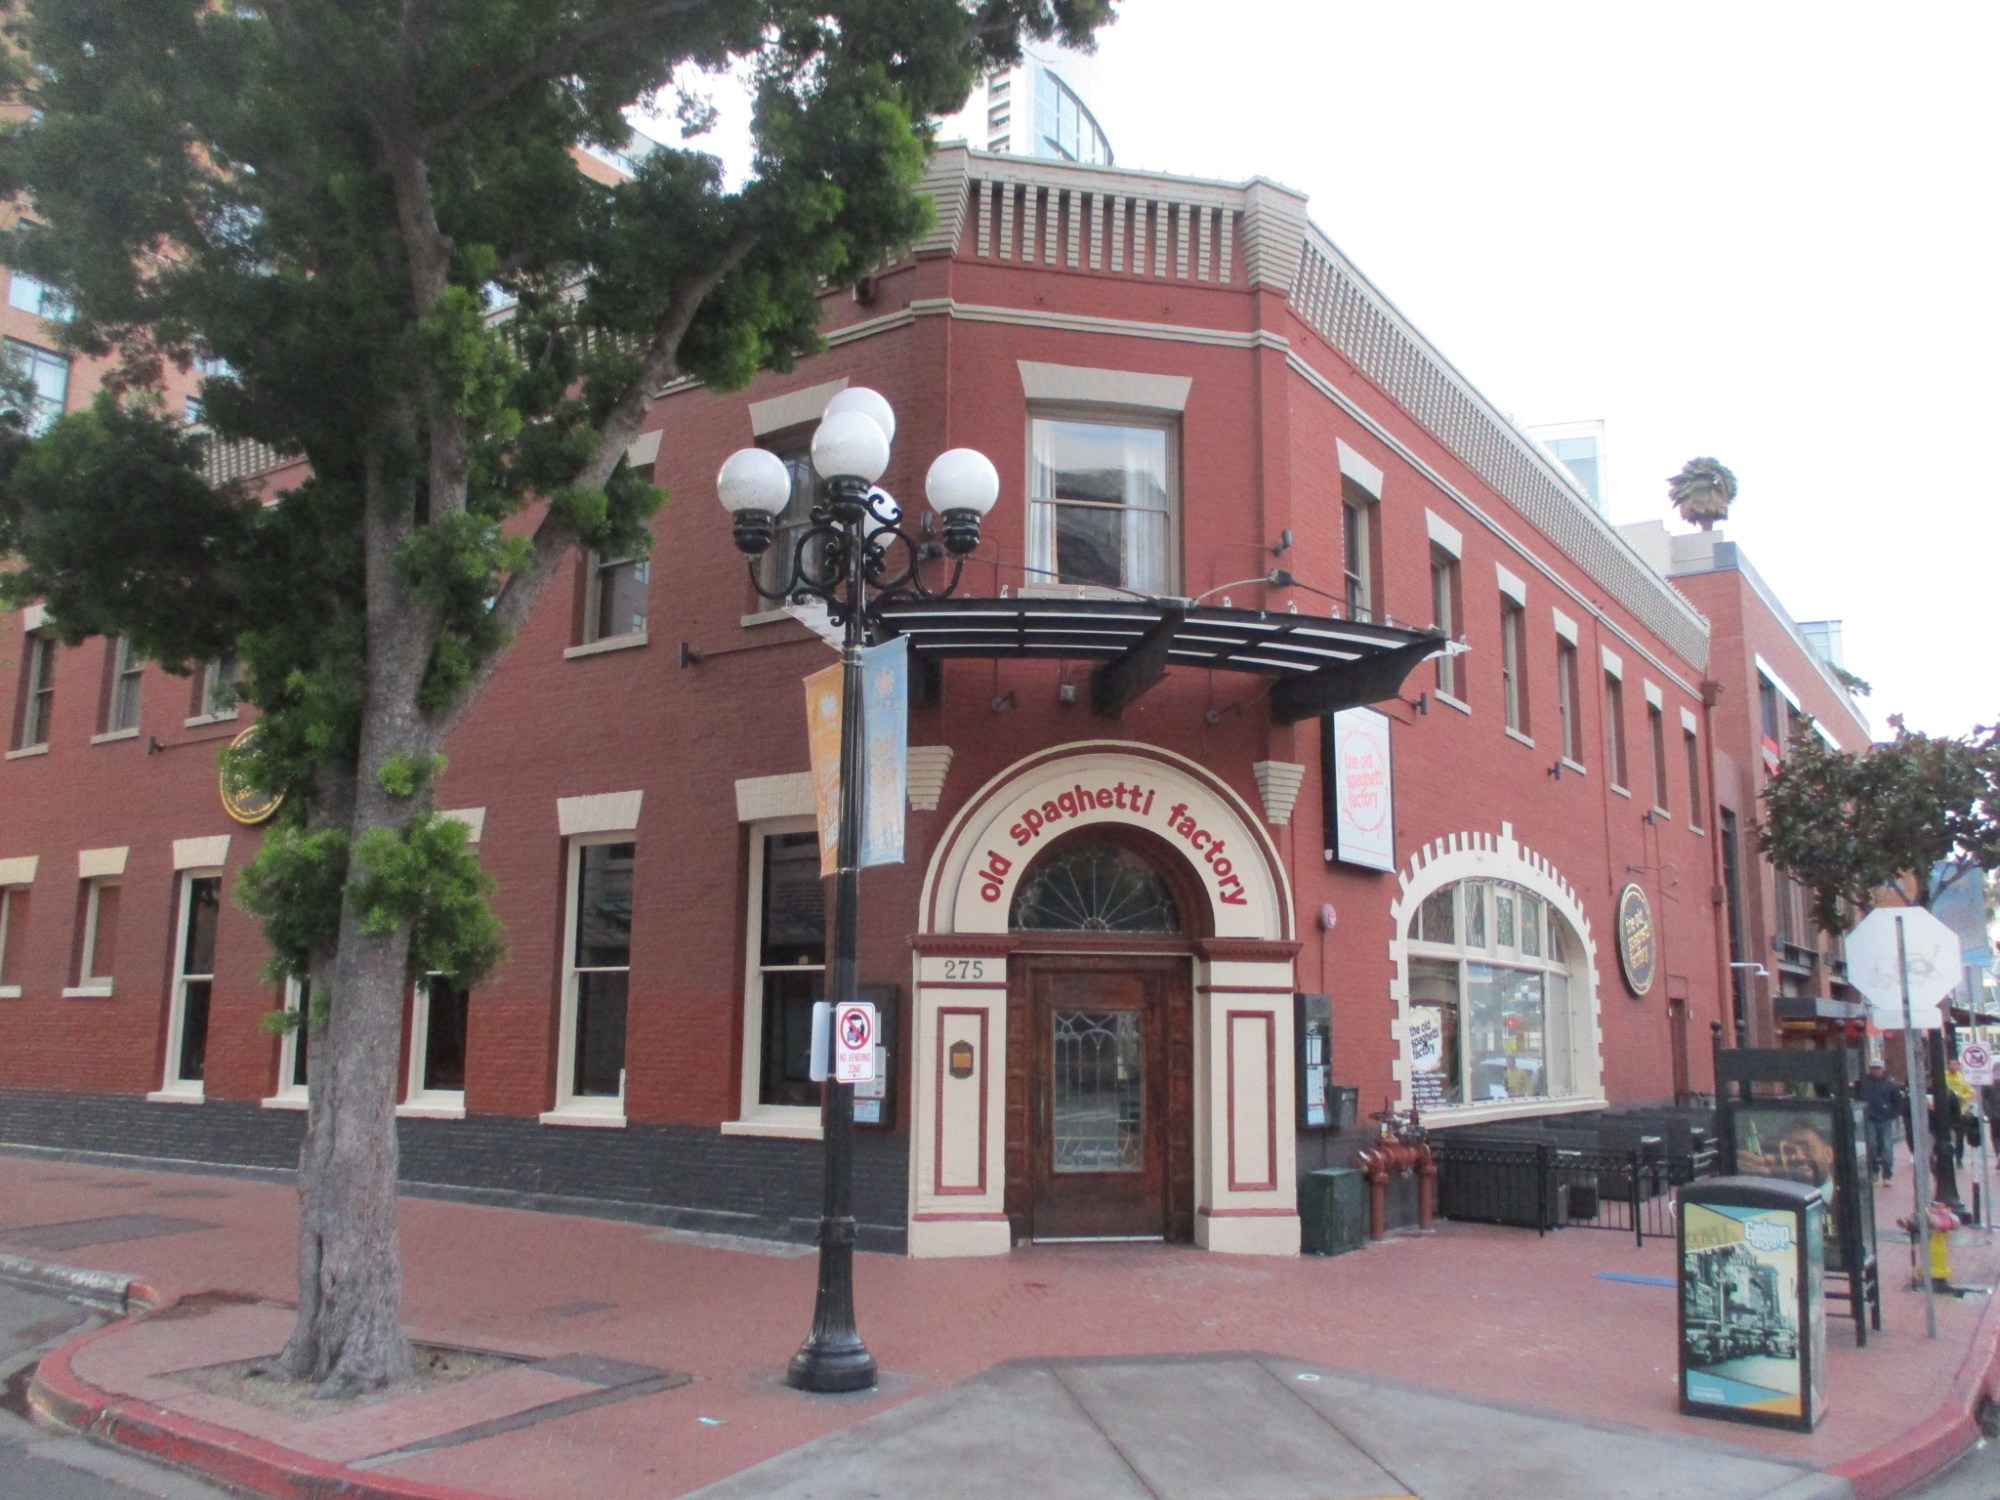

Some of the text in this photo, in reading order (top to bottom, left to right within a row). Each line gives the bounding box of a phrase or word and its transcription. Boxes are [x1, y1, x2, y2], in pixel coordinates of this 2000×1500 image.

[978, 781, 1247, 906] old spaghetti factory
[944, 960, 983, 979] 275
[1409, 1019, 1431, 1037] the old
